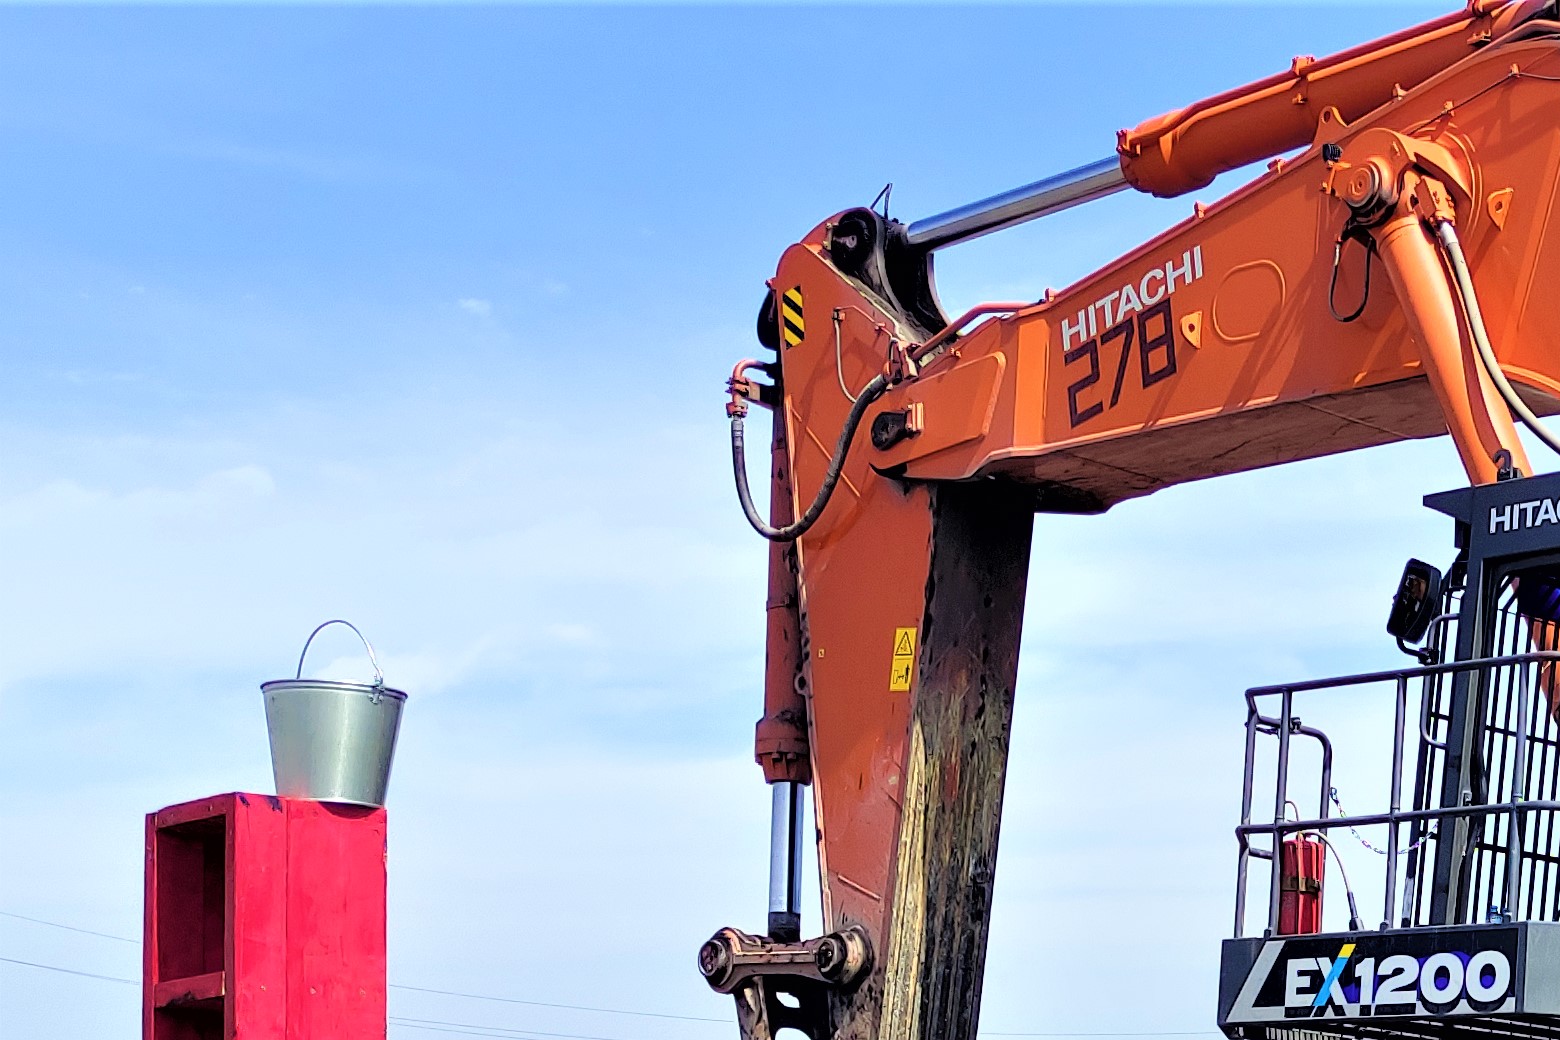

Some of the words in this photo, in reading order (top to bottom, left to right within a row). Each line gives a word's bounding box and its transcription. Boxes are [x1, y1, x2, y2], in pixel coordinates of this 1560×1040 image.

[1061, 245, 1203, 352] HITACHI
[1064, 297, 1178, 429] 278
[1284, 944, 1511, 1010] EX1200
